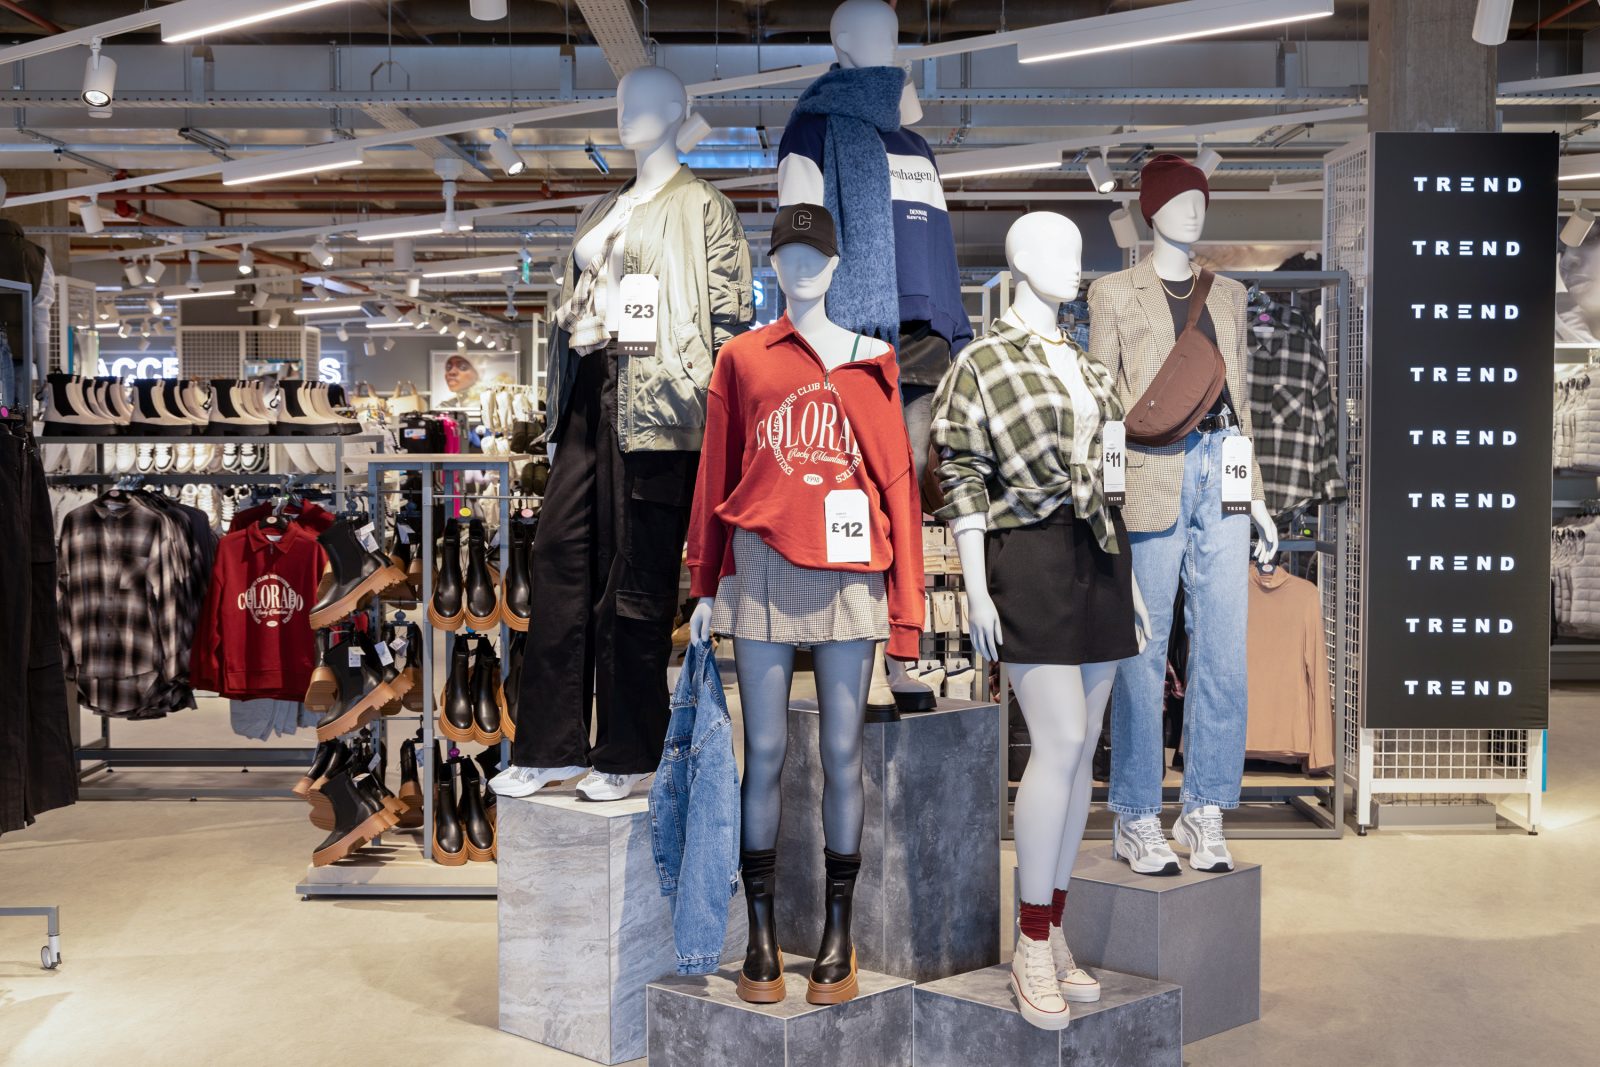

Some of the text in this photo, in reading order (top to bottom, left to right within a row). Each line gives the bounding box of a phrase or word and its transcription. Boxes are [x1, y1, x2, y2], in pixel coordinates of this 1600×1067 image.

[1413, 176, 1522, 193] TREND
[792, 210, 812, 231] C
[1412, 240, 1521, 257] TREND
[624, 304, 655, 319] £23
[1411, 303, 1519, 320] TREND
[1410, 366, 1518, 383] TREND
[797, 382, 820, 396] CLUB
[756, 400, 863, 457] COLORA
[1409, 429, 1517, 446] TREND
[787, 446, 849, 466] Rocky Mountains
[1105, 451, 1121, 468] £11
[1225, 464, 1247, 479] £16
[1408, 492, 1516, 509] TREND
[831, 521, 864, 538] £12
[1407, 555, 1515, 572] TREND
[237, 585, 304, 612] COLORADO
[1405, 617, 1514, 634] TREND
[1404, 680, 1513, 696] TREND
